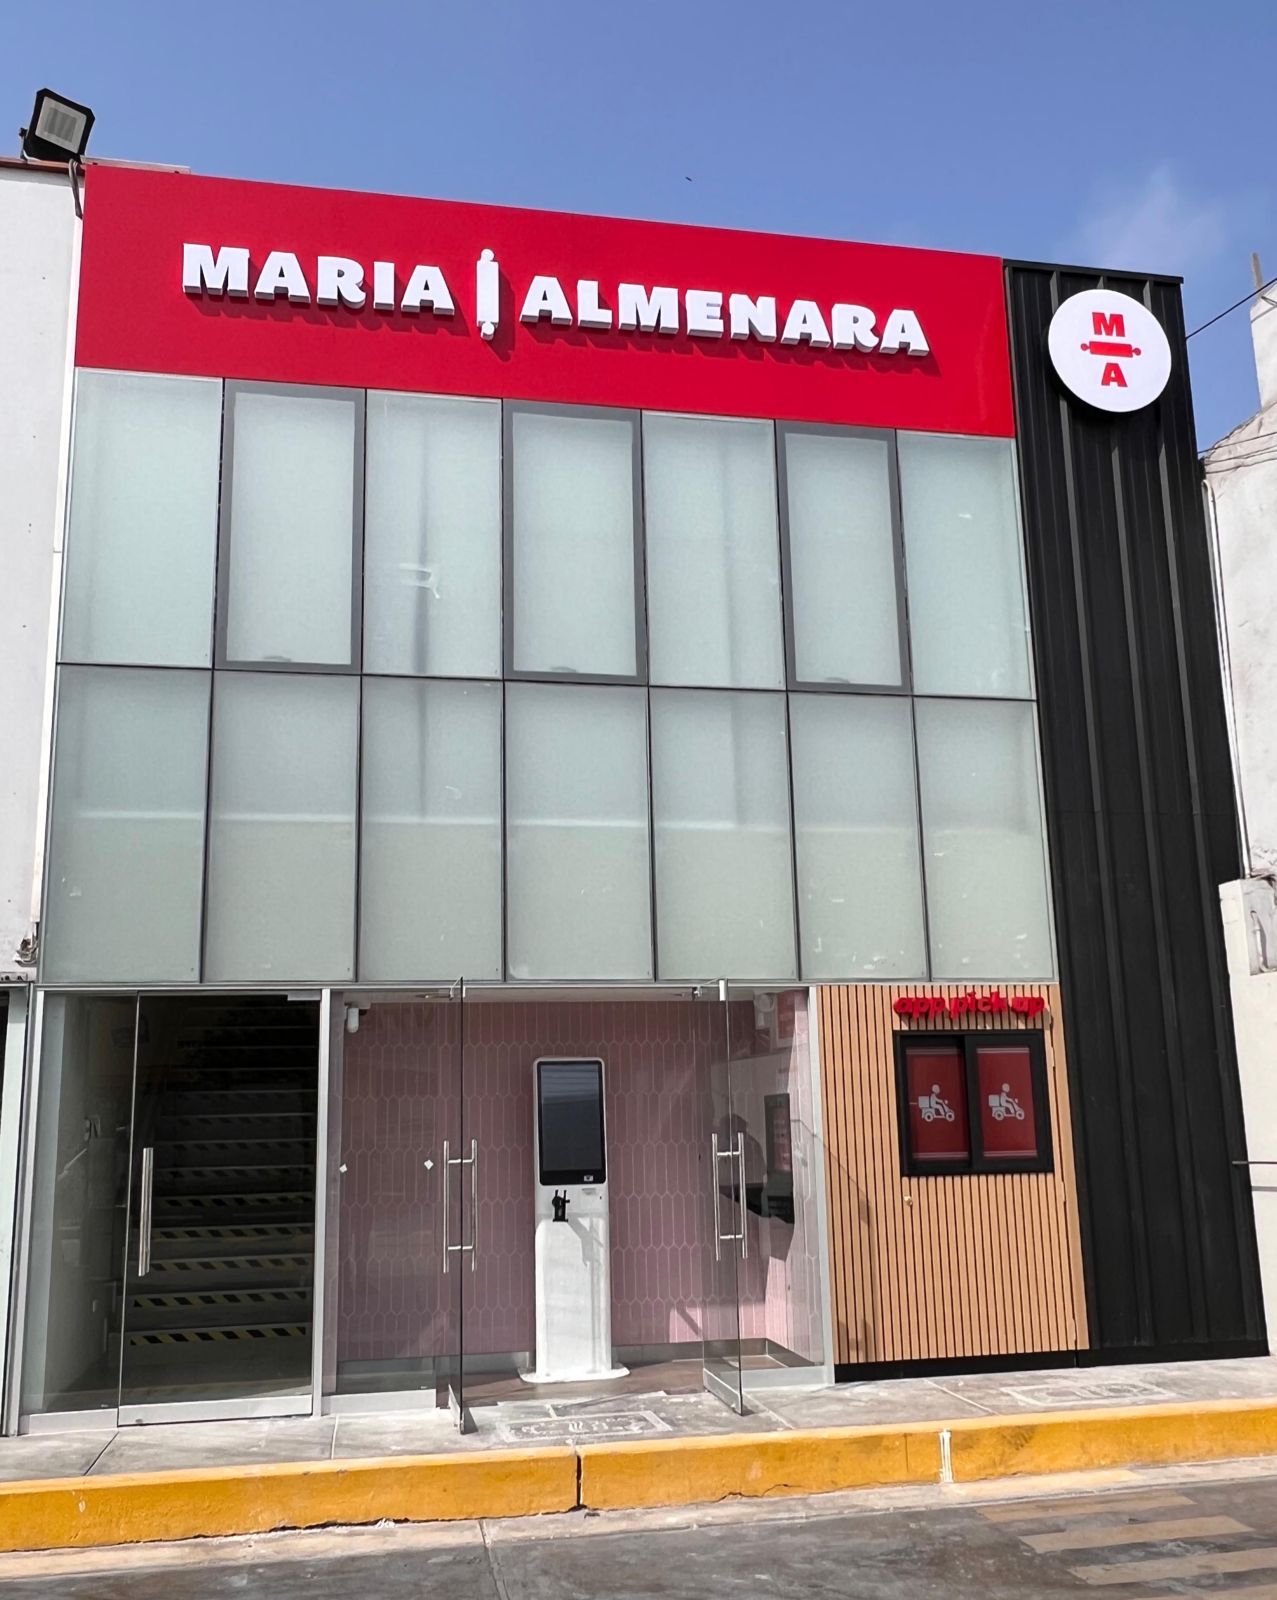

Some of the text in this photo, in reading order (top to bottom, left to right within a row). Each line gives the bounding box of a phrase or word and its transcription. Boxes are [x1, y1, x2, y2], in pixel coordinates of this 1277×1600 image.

[182, 242, 931, 357] MARIA ALMENARA
[1092, 312, 1126, 338] M
[1100, 362, 1128, 388] A
[893, 991, 1045, 1020] app pick up
